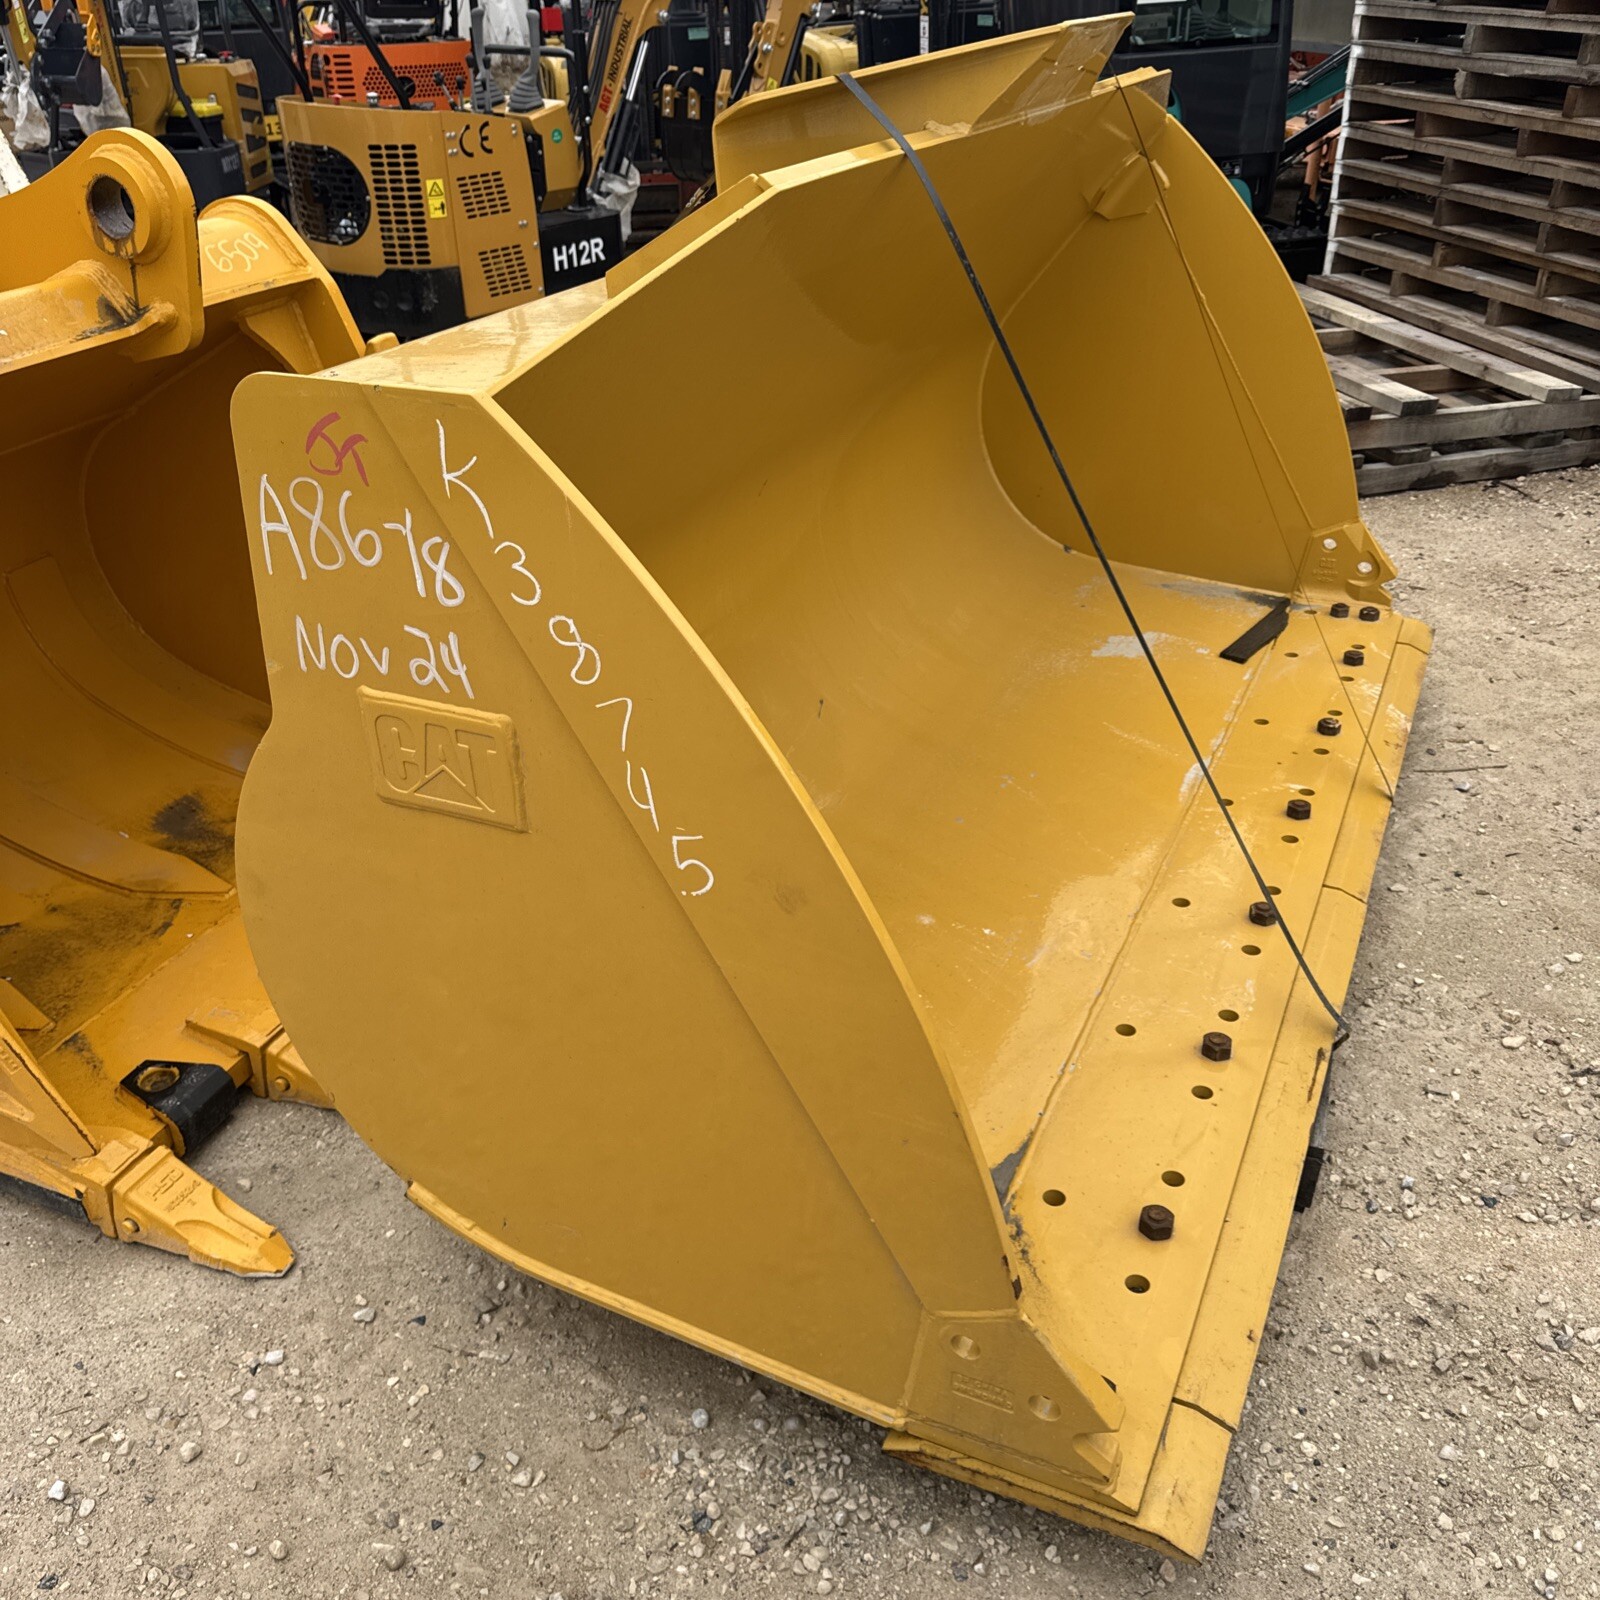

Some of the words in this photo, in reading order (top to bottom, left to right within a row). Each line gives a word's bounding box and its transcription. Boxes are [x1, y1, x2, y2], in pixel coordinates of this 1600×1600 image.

[459, 120, 494, 158] CE
[552, 237, 607, 272] H12R
[403, 624, 475, 699] 24
[374, 714, 498, 814] CAT
